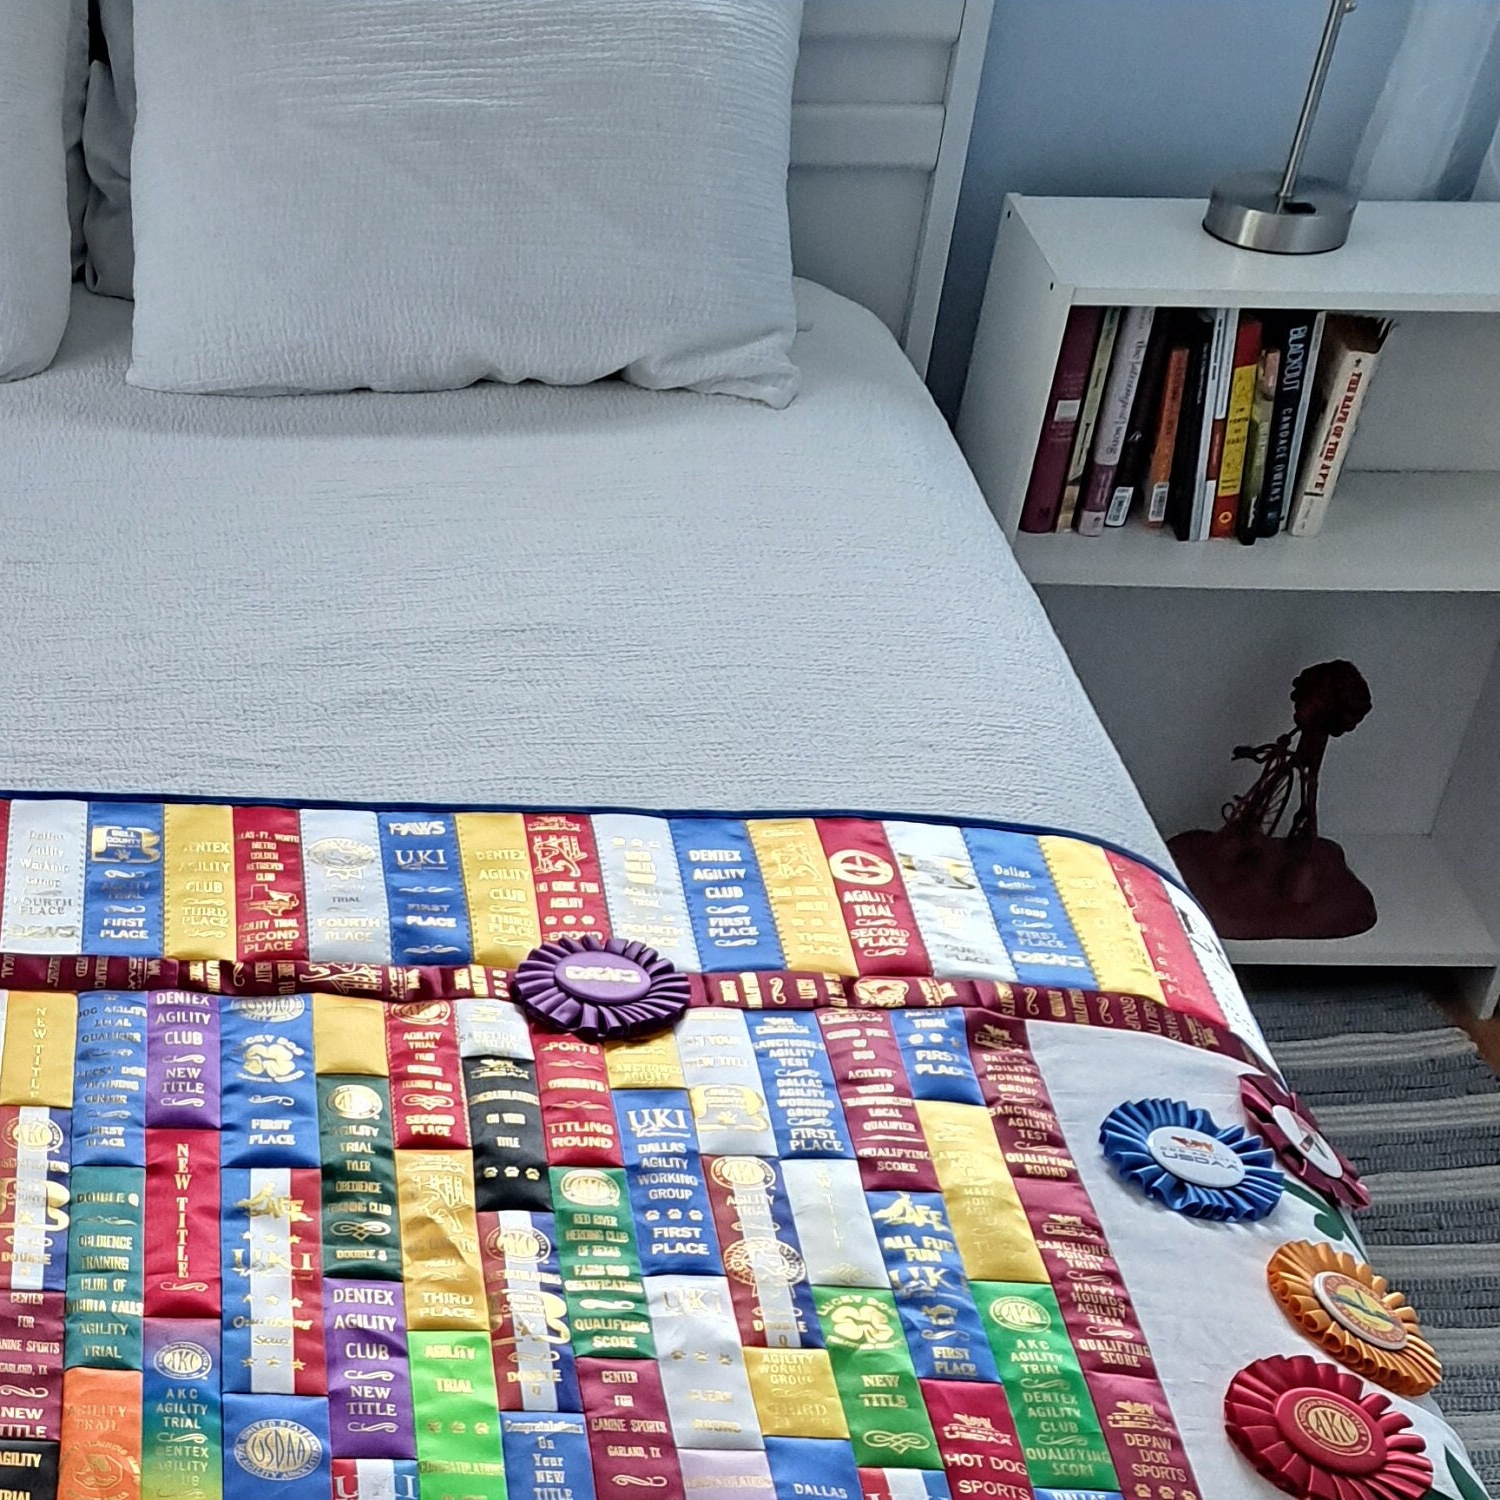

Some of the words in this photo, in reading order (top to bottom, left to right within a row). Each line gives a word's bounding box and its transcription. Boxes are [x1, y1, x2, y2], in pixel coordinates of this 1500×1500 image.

[1283, 325, 1308, 392] BLACKOUT
[1348, 372, 1362, 390] THE
[1338, 394, 1357, 424] RAPE
[1276, 407, 1293, 464] CANDACE
[1331, 425, 1344, 440] OF
[1324, 441, 1339, 462] THE
[1270, 464, 1285, 503] OWENS
[688, 849, 742, 863] DENTEX
[692, 868, 747, 881] AGILITY
[993, 864, 1031, 879] Dallas
[705, 886, 744, 900] CLUB
[1010, 903, 1047, 920] Group
[104, 917, 147, 927] FIRST
[100, 929, 149, 940] PLACE
[156, 1012, 211, 1025] AGILITY
[165, 1032, 203, 1045] CLUB
[165, 1067, 202, 1079] NEW
[162, 1082, 205, 1094] TITLE
[175, 1143, 193, 1191] NEW
[1161, 1150, 1240, 1173] USDAA
[175, 1196, 190, 1279] TITLE
[1314, 1411, 1357, 1446] AKC
[1123, 1433, 1172, 1451] DEPAW
[944, 1453, 984, 1468] HOT
[989, 1456, 1028, 1476] DOG
[1140, 1449, 1169, 1464] DOG
[1132, 1464, 1188, 1483] SPORTS
[958, 1480, 1031, 1500] SPORTS
